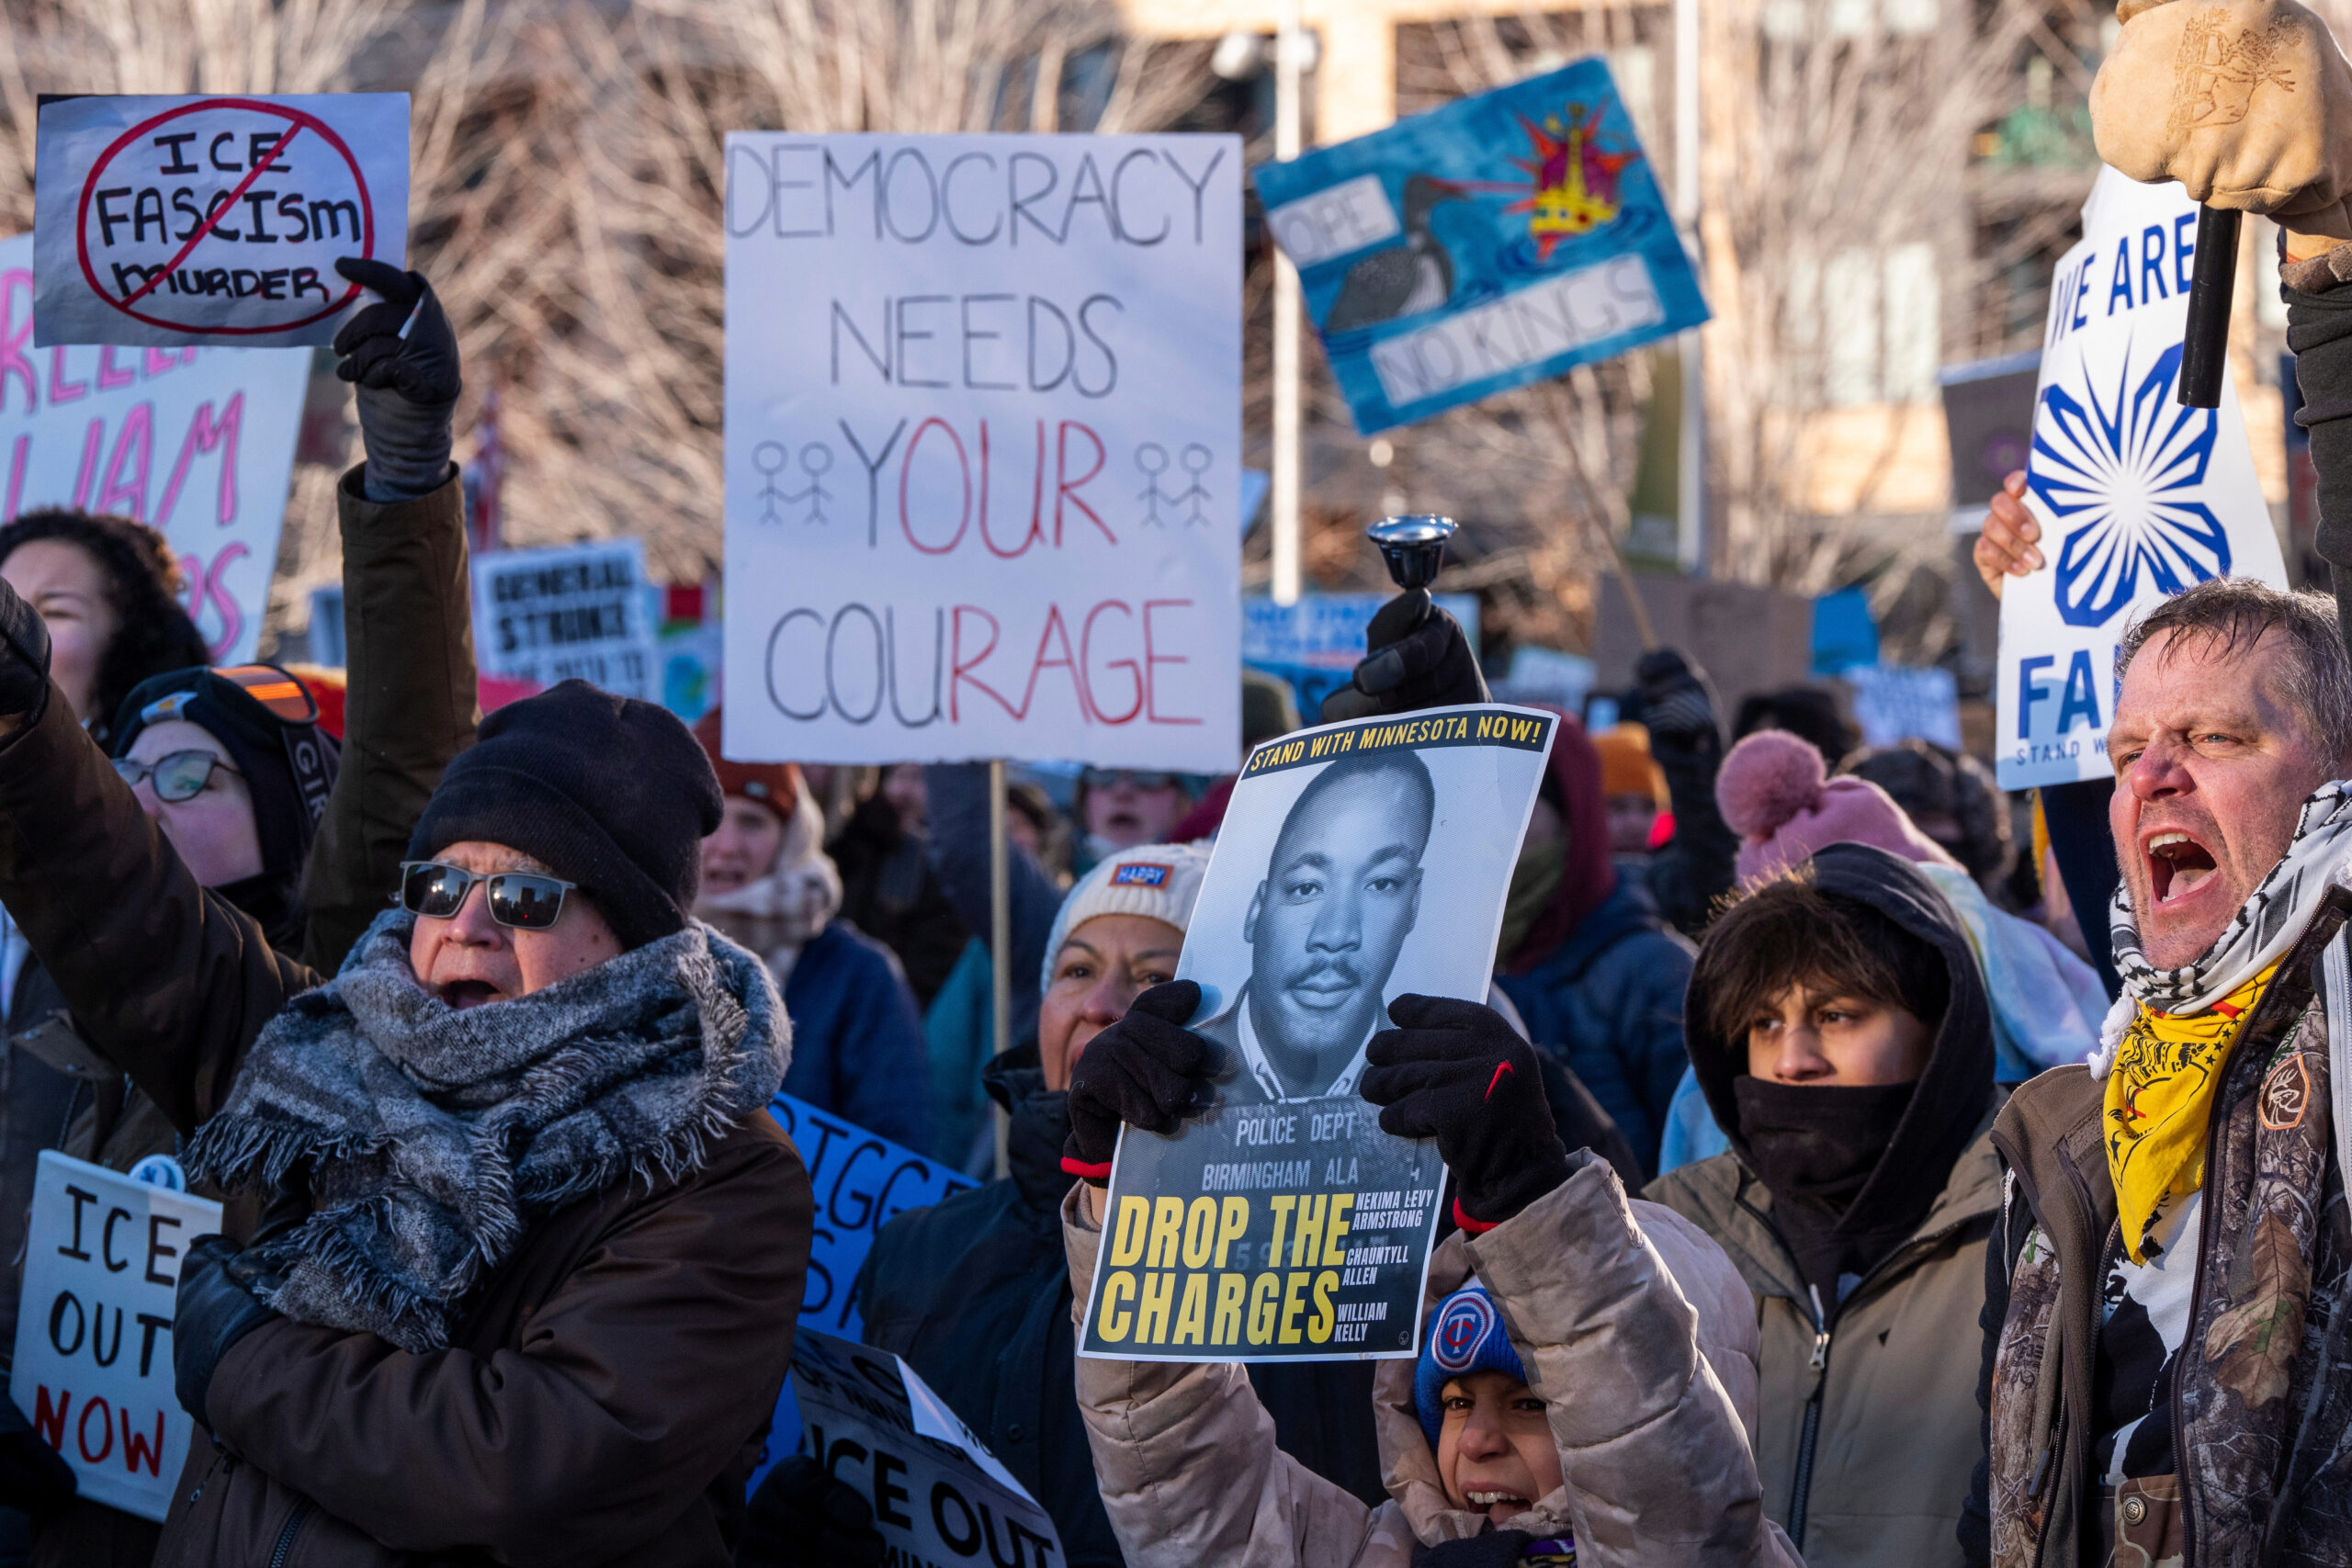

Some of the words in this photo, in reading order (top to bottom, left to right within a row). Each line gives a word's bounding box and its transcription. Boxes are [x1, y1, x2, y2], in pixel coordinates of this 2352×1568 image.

[153, 132, 291, 175] ICE
[725, 143, 1226, 248] DEMOCRACY
[1278, 190, 1376, 257] OPE
[2050, 253, 2096, 349] WE
[2108, 211, 2197, 317] ARE
[831, 294, 1125, 400] NEEDS
[1378, 324, 1464, 401] NO
[1466, 263, 1655, 363] KINGS
[838, 415, 1117, 560] YOUR
[764, 599, 1205, 728] COURAGE
[2018, 644, 2123, 739] FA
[295, 740, 328, 820] GIR
[1250, 742, 1303, 772] STAND
[1309, 731, 1355, 758] WITH
[1359, 716, 1468, 750] MINNESOTA
[1476, 716, 1542, 743] NOW!
[2016, 740, 2080, 766] STAND
[1235, 1115, 1298, 1147] POLICE
[1310, 1112, 1357, 1143] DEPT
[1202, 1159, 1312, 1191] BIRMINGHAM
[1324, 1156, 1359, 1186] ALA
[1356, 1191, 1401, 1211] NEKIMA
[1404, 1190, 1434, 1208] LEVY
[58, 1184, 182, 1288] ICE
[1110, 1196, 1250, 1268] DROP
[1268, 1193, 1355, 1268] THE
[1346, 1246, 1408, 1266] CHAUNTYLL
[1351, 1210, 1423, 1231] ARMSTRONG
[1097, 1269, 1340, 1346] CHARGES
[1337, 1302, 1388, 1322] WILLIAM
[1341, 1267, 1378, 1286] ALLEN
[49, 1290, 173, 1378] OUT
[1334, 1323, 1368, 1342] KELLY
[34, 1384, 164, 1478] NOW
[810, 1423, 913, 1532] ICE
[930, 1481, 1056, 1568] OUT
